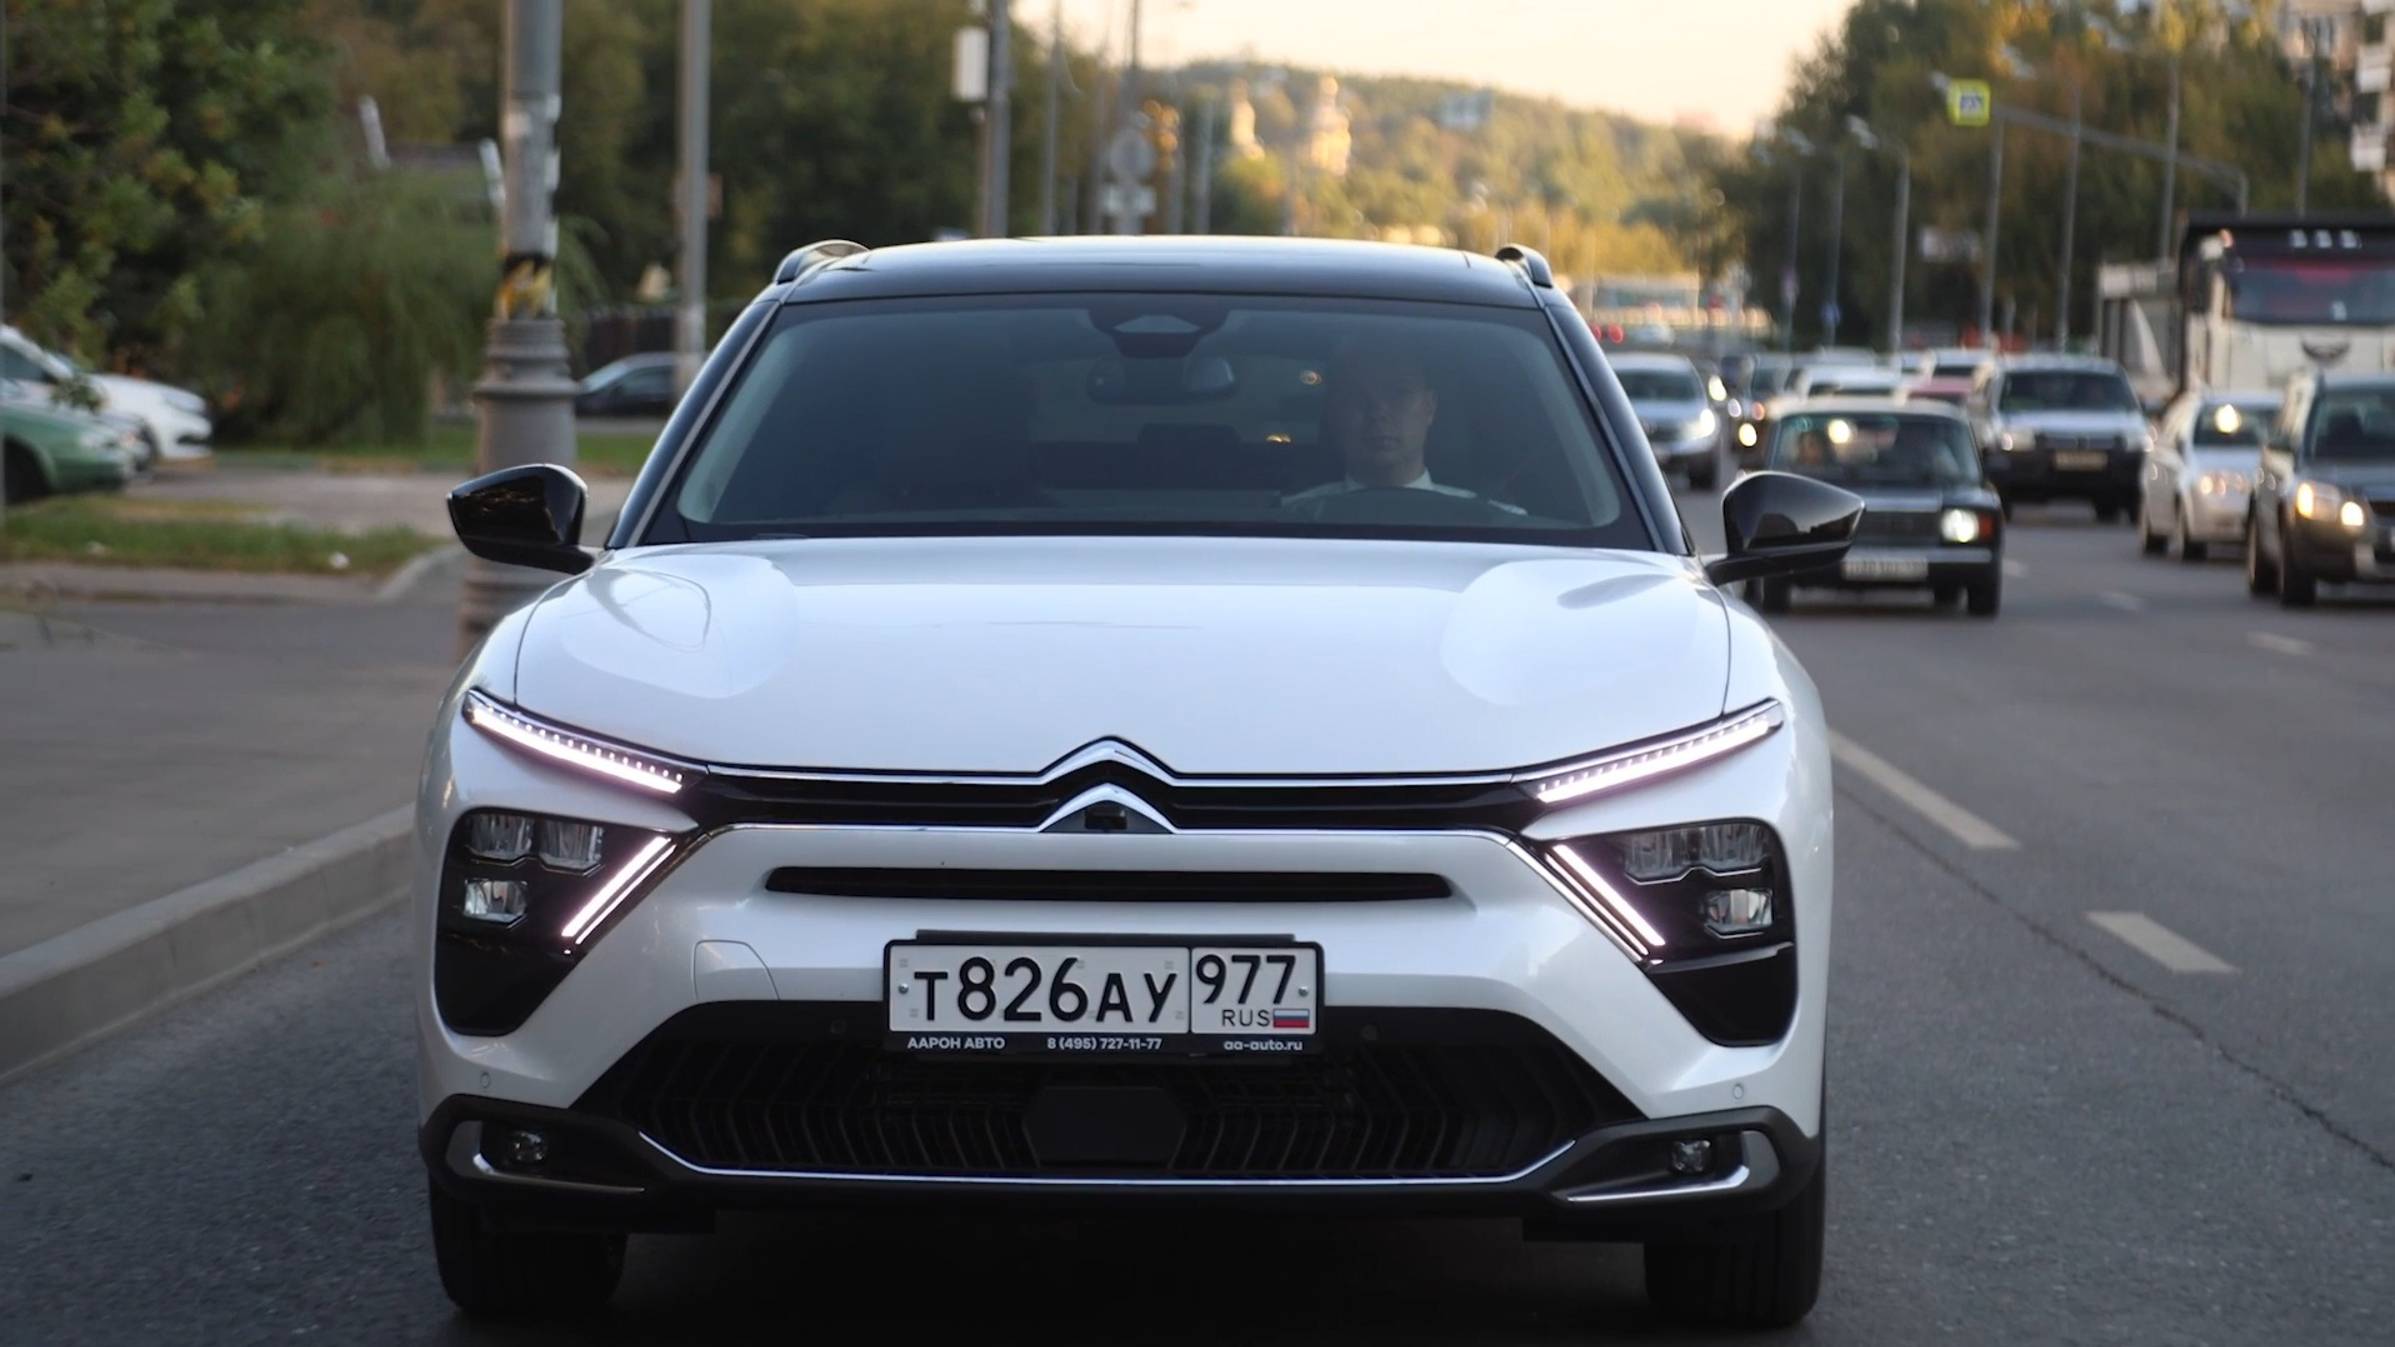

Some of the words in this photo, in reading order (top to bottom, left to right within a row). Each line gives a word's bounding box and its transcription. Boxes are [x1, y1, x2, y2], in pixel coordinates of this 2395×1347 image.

[1196, 954, 1297, 1005] 977
[1221, 1009, 1271, 1027] RUS
[907, 1037, 960, 1050] ААРОН
[963, 1037, 1006, 1050] АВТО
[1047, 1038, 1057, 1050] 8
[1058, 1038, 1097, 1051] (495)
[1100, 1038, 1163, 1050] 727-11-77
[1224, 1040, 1303, 1051] aa-auto.ru
